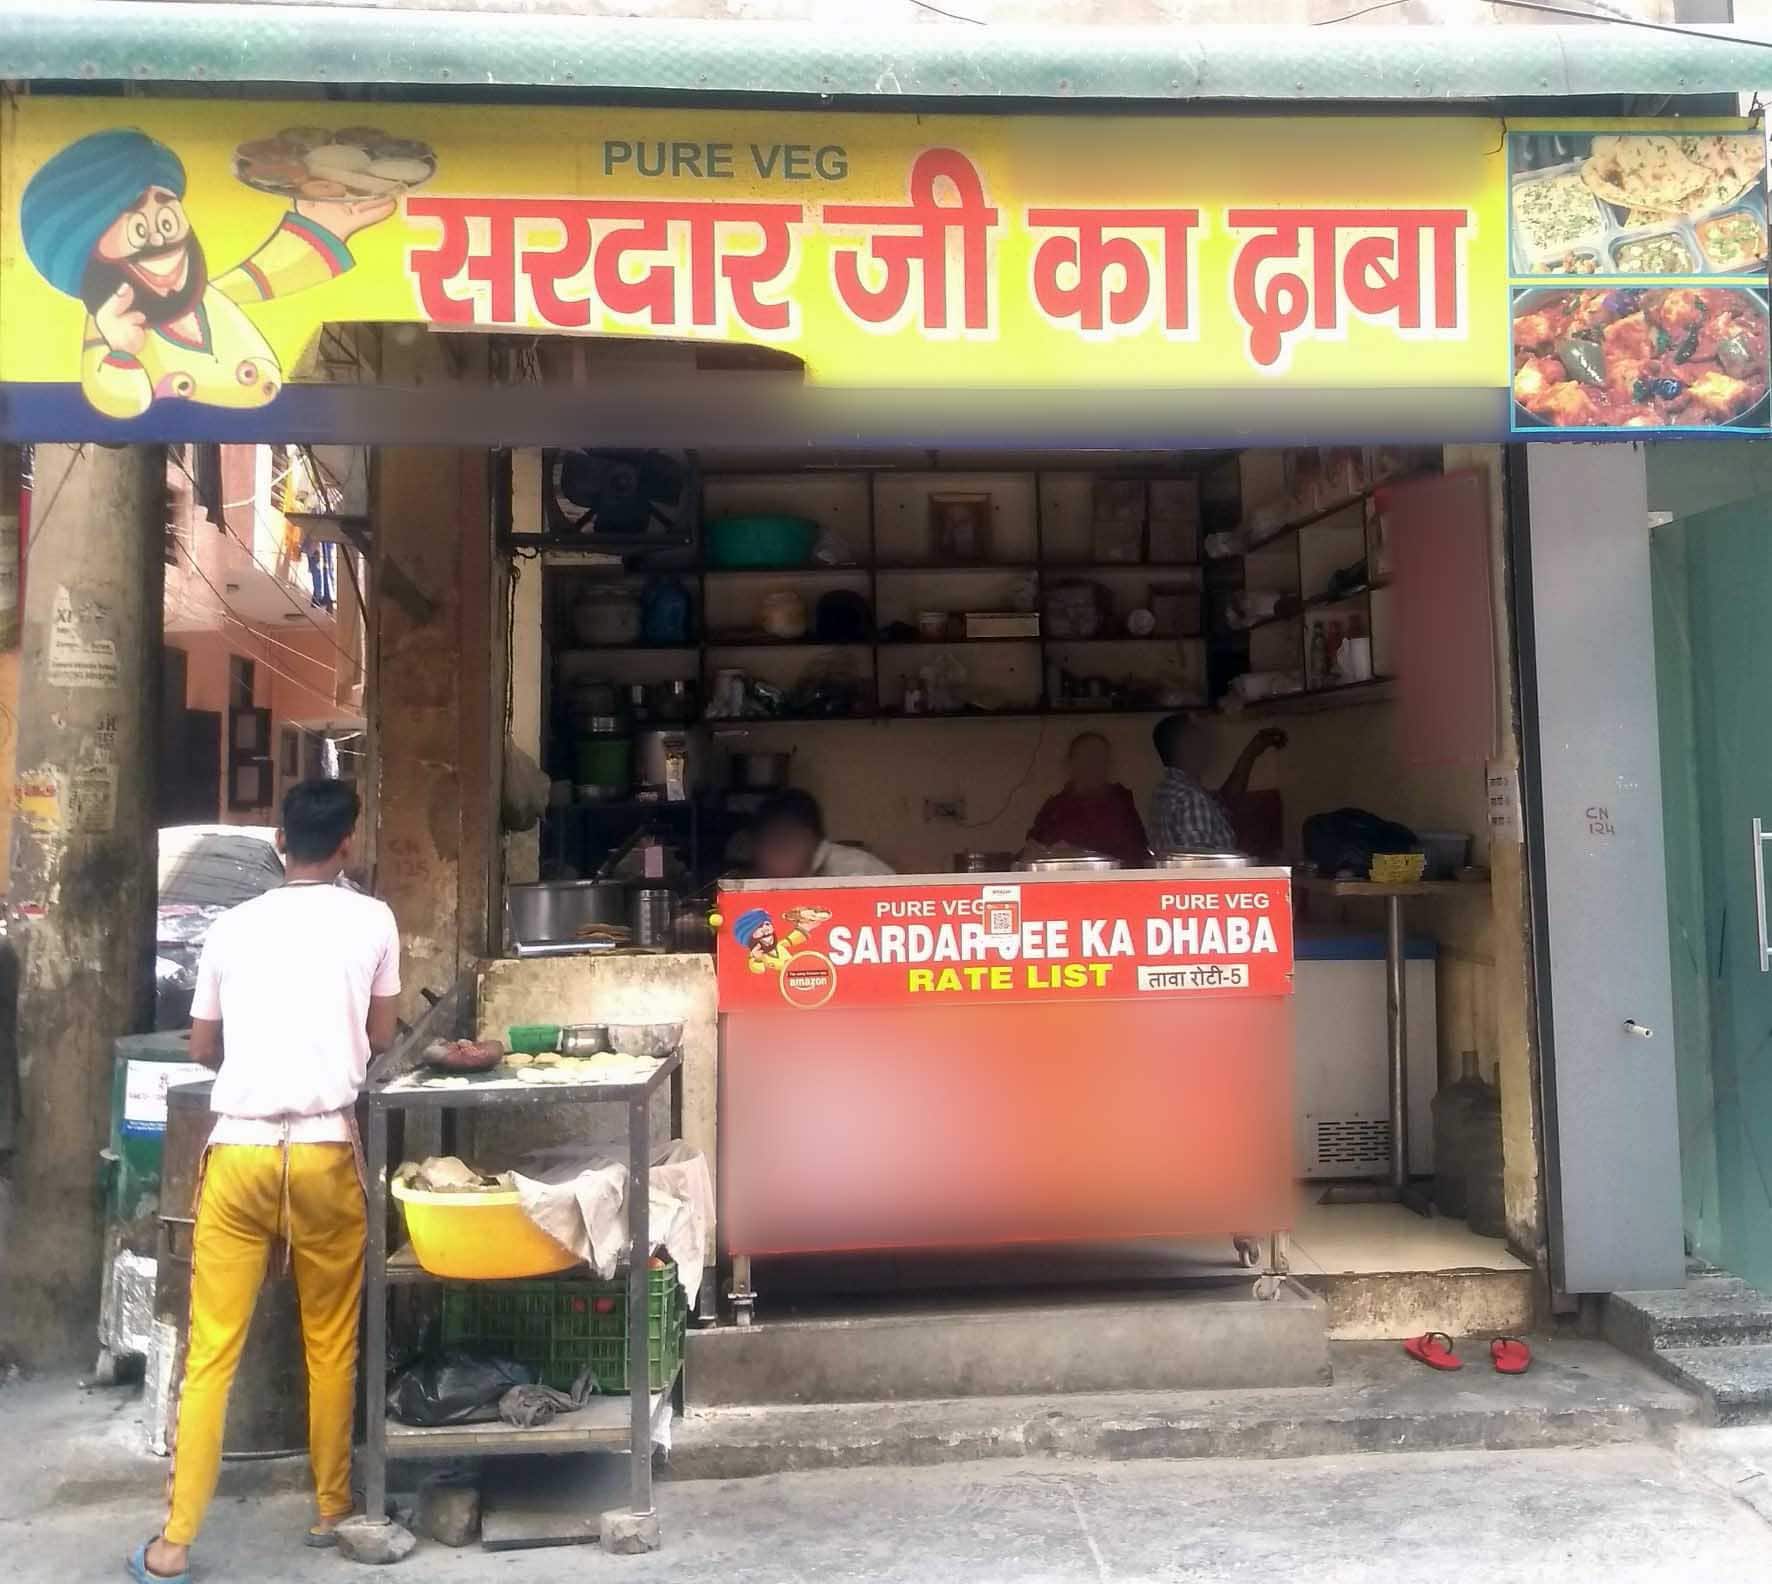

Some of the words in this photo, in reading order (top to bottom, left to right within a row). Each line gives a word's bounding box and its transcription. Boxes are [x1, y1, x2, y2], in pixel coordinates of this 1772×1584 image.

[603, 140, 735, 178] PURE
[750, 143, 849, 181] VEG
[407, 197, 804, 330] सरदार
[823, 147, 998, 330] जी
[1027, 208, 1199, 331] का
[876, 900, 937, 918] PURE
[942, 899, 985, 917] VEG
[1160, 893, 1220, 911] PURE
[1224, 892, 1270, 910] VEG
[828, 921, 987, 966] SARDAR
[1081, 918, 1136, 958] KA
[1146, 915, 1279, 956] DHABA
[908, 965, 1014, 993] RATE
[1026, 962, 1113, 990] LIST
[1147, 970, 1186, 989] तावा
[1190, 965, 1242, 987] रोटी-5
